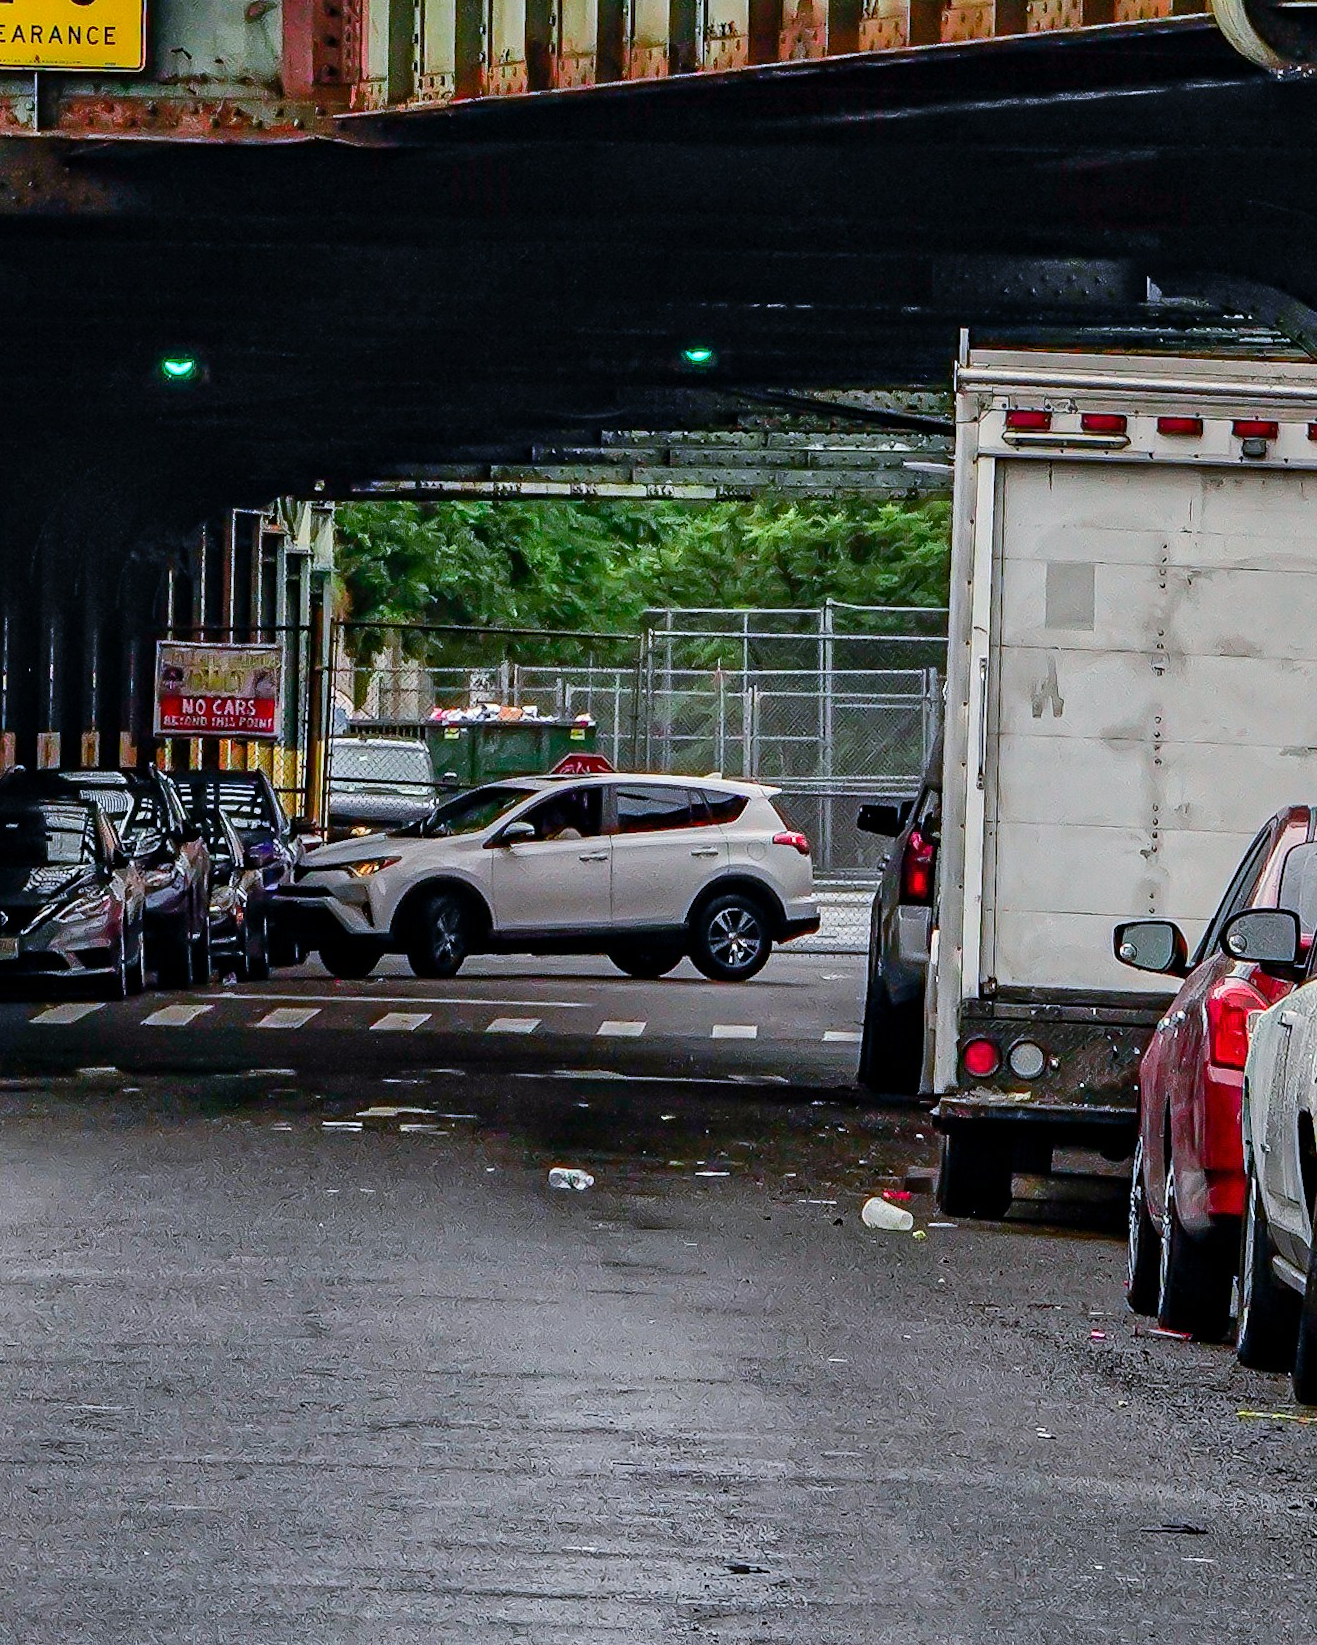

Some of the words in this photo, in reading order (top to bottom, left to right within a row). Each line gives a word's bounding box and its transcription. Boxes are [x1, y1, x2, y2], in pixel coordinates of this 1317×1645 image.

[182, 698, 206, 715] NO
[212, 699, 256, 716] CARS
[163, 715, 208, 727] BEYOND
[211, 716, 236, 728] THIS
[239, 717, 273, 729] POINT
